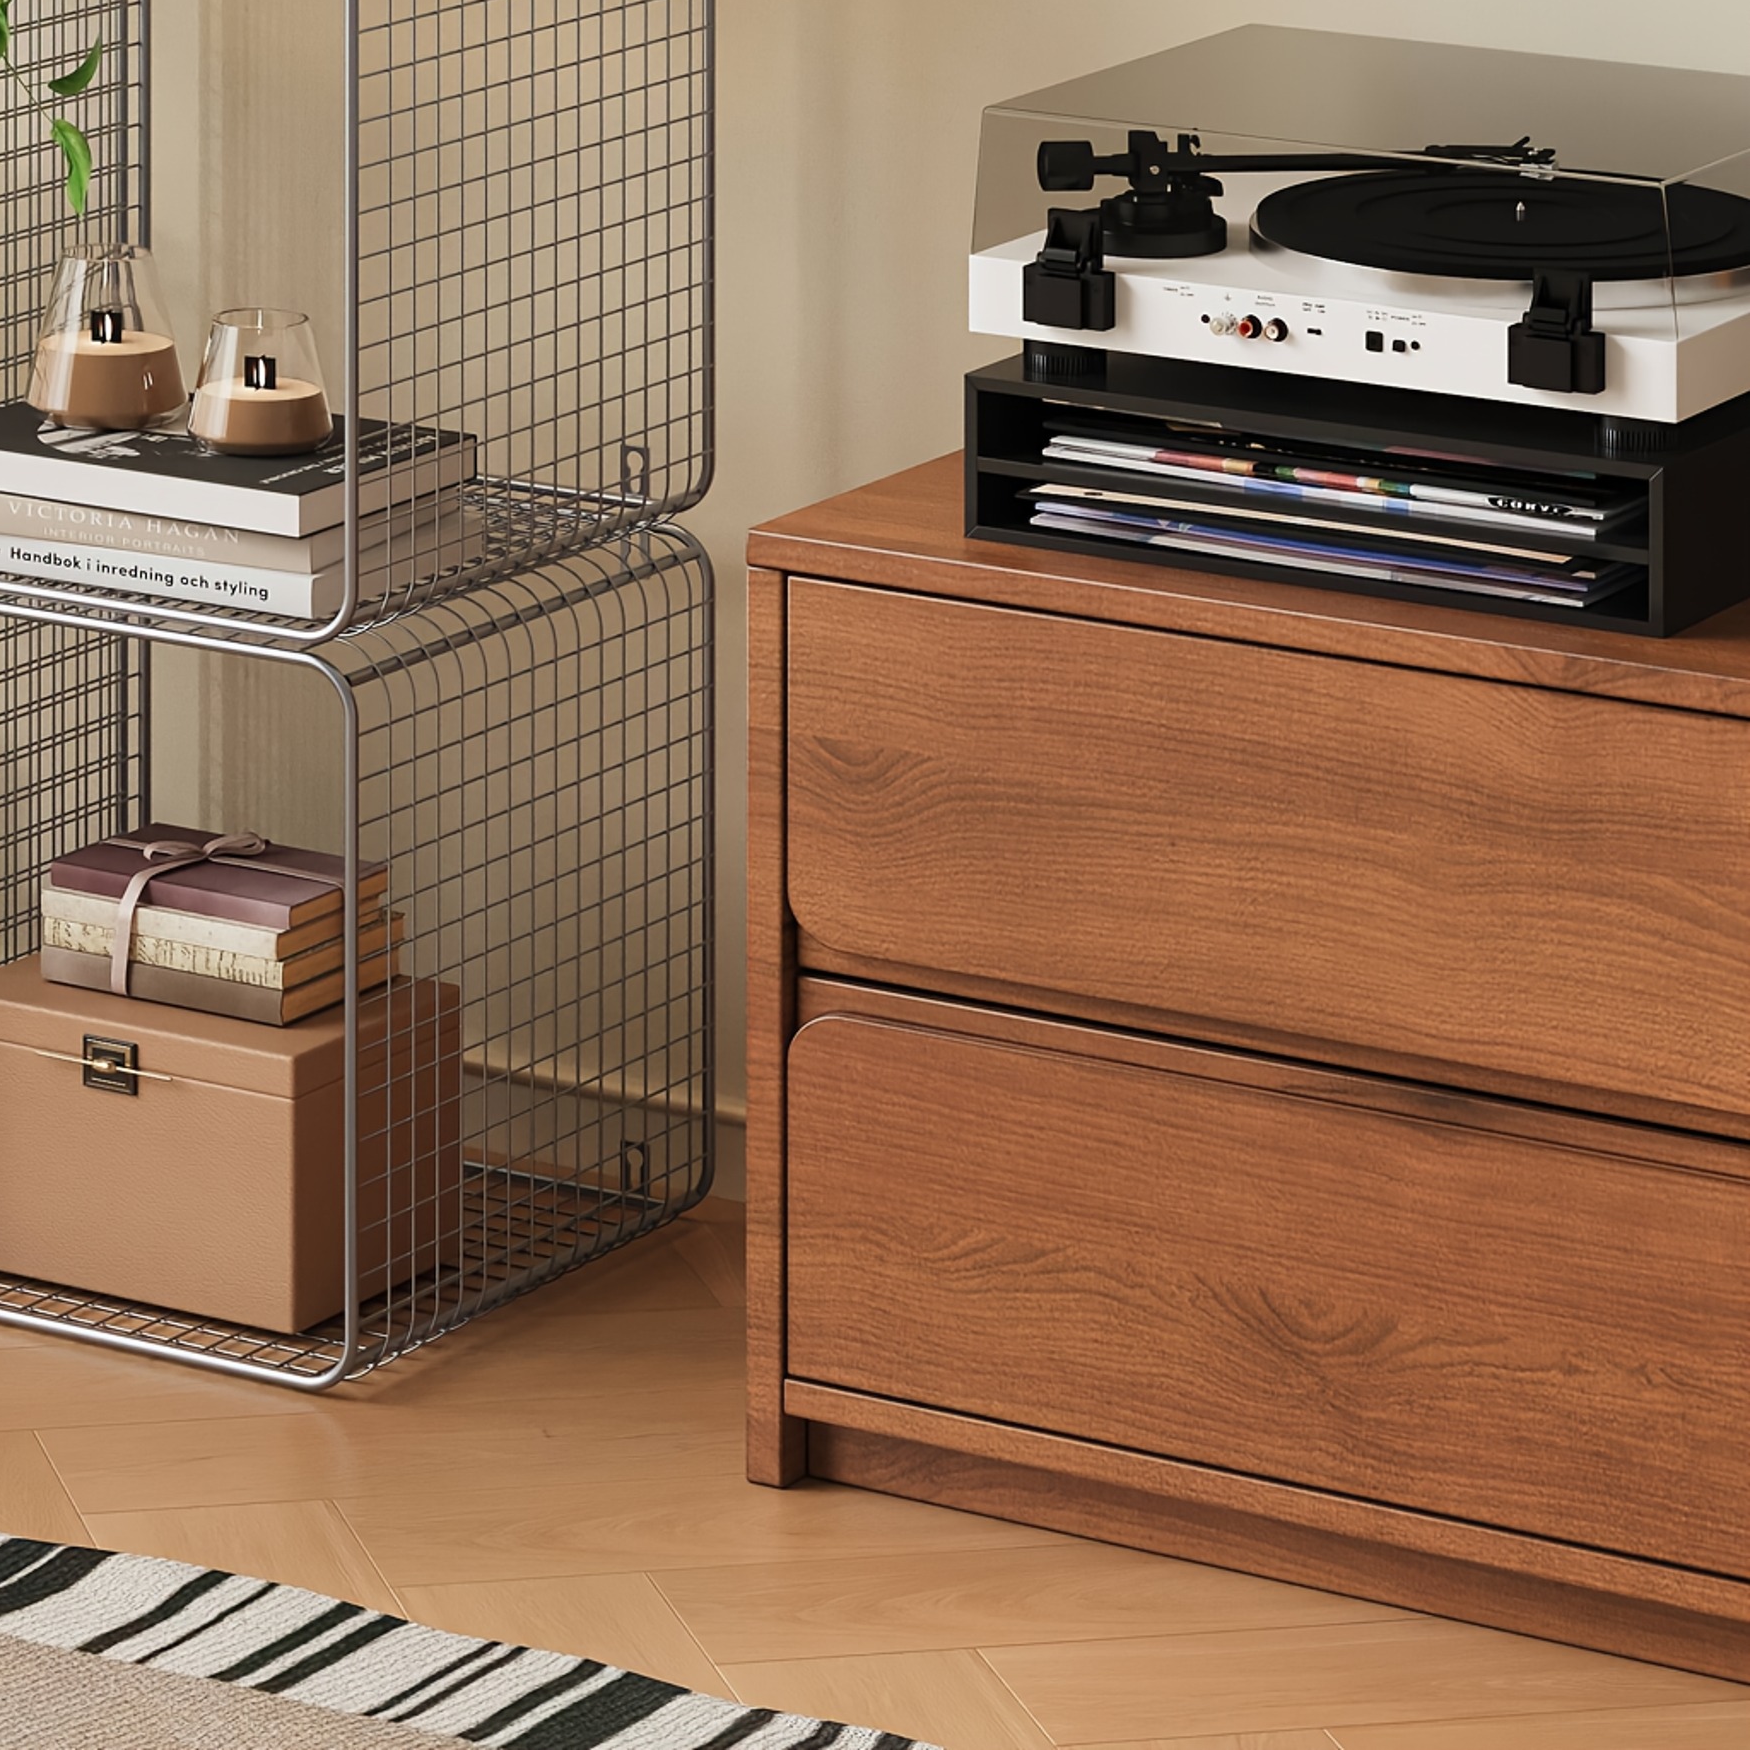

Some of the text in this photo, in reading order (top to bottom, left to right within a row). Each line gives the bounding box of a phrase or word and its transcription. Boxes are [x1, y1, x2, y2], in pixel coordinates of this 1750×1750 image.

[9, 500, 241, 544] VICTORIA HAGAN
[43, 526, 206, 557] INTERIOR PORTRAITS
[9, 547, 269, 602] Handbok i inredning och styling
